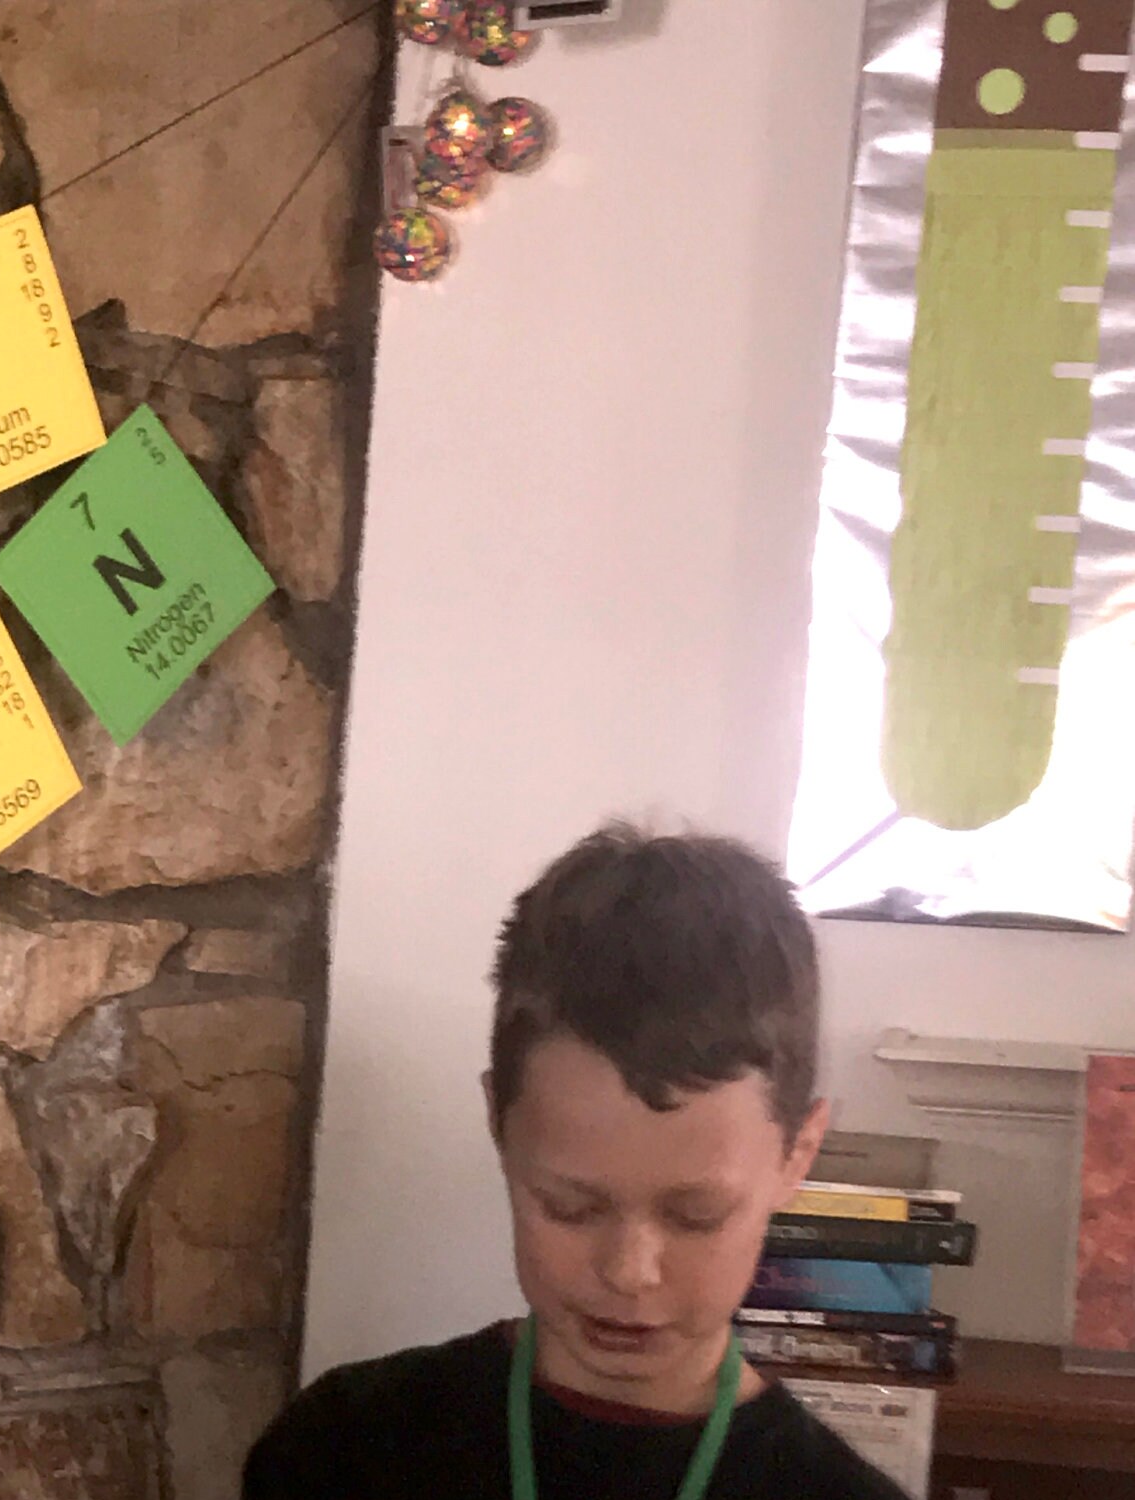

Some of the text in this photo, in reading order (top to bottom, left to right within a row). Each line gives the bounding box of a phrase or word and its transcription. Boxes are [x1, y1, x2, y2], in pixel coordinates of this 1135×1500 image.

[14, 228, 28, 250] 2
[23, 253, 37, 274] 8
[20, 278, 45, 303] 18
[38, 303, 53, 323] 9
[45, 326, 61, 348] 2
[149, 447, 167, 466] 5
[69, 491, 96, 531] 7
[91, 527, 167, 617] N
[125, 582, 207, 664] Nitrogen
[144, 601, 215, 681] 14.0067
[2, 691, 26, 716] 18
[23, 713, 35, 729] 1
